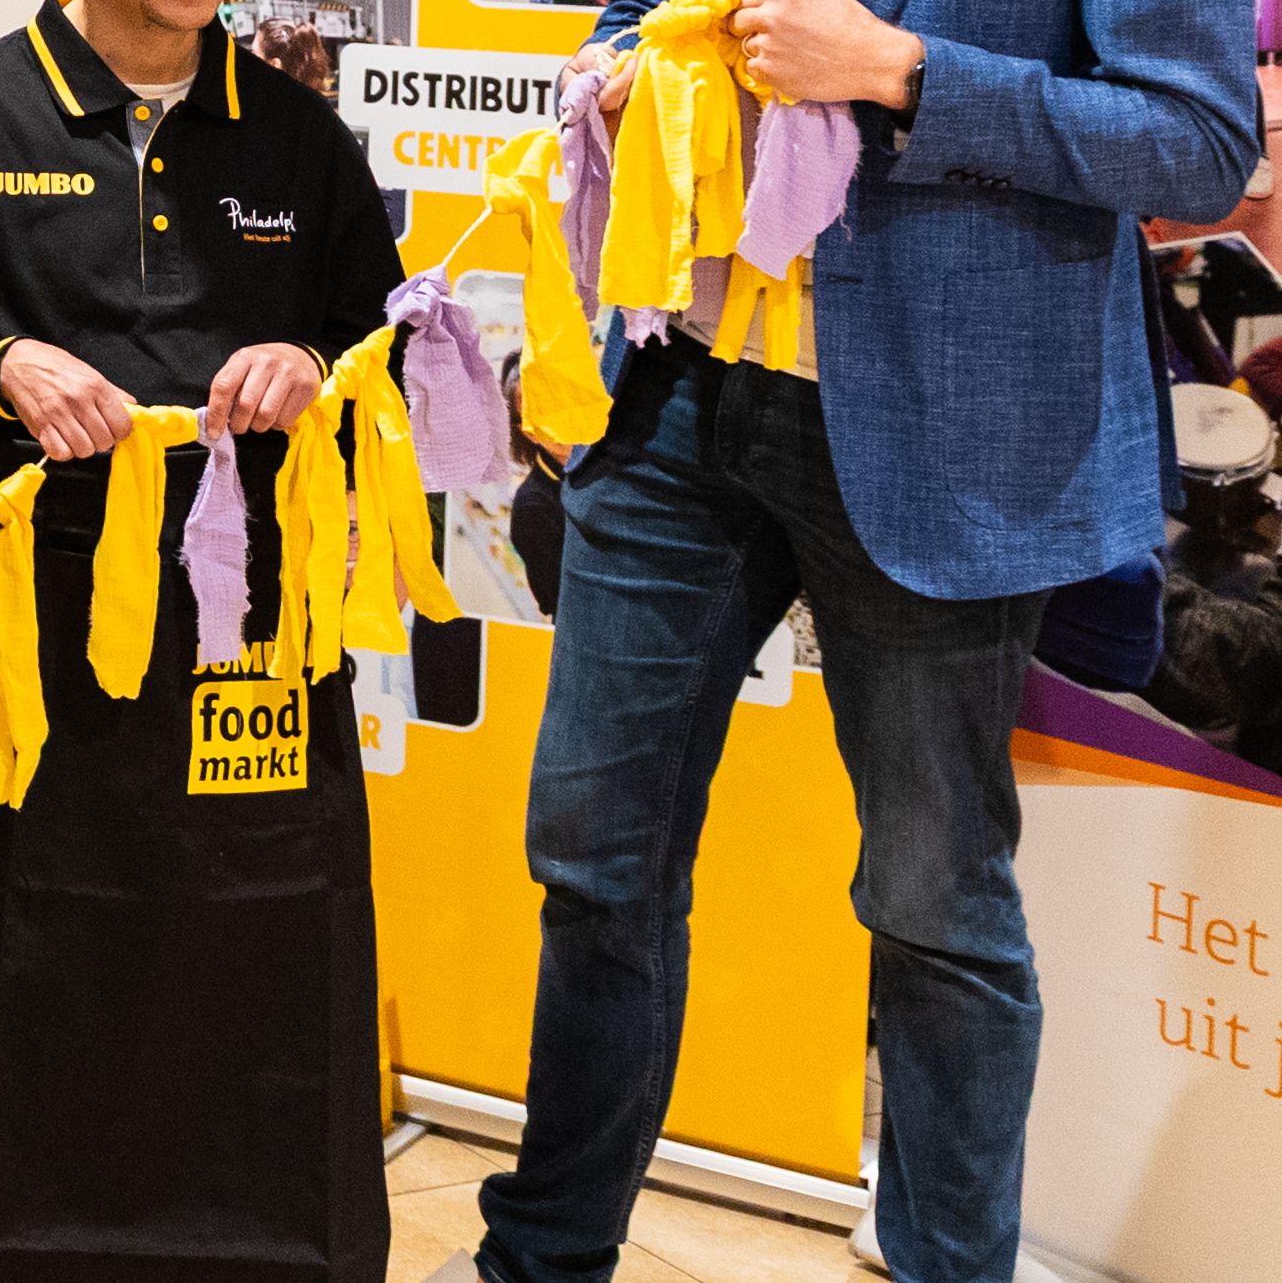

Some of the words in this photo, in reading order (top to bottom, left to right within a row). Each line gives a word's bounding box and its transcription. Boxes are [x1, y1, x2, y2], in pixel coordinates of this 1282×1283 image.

[199, 688, 302, 742] food
[199, 746, 299, 781] markt
[1146, 881, 1270, 977] Het
[1155, 997, 1251, 1070] uit
